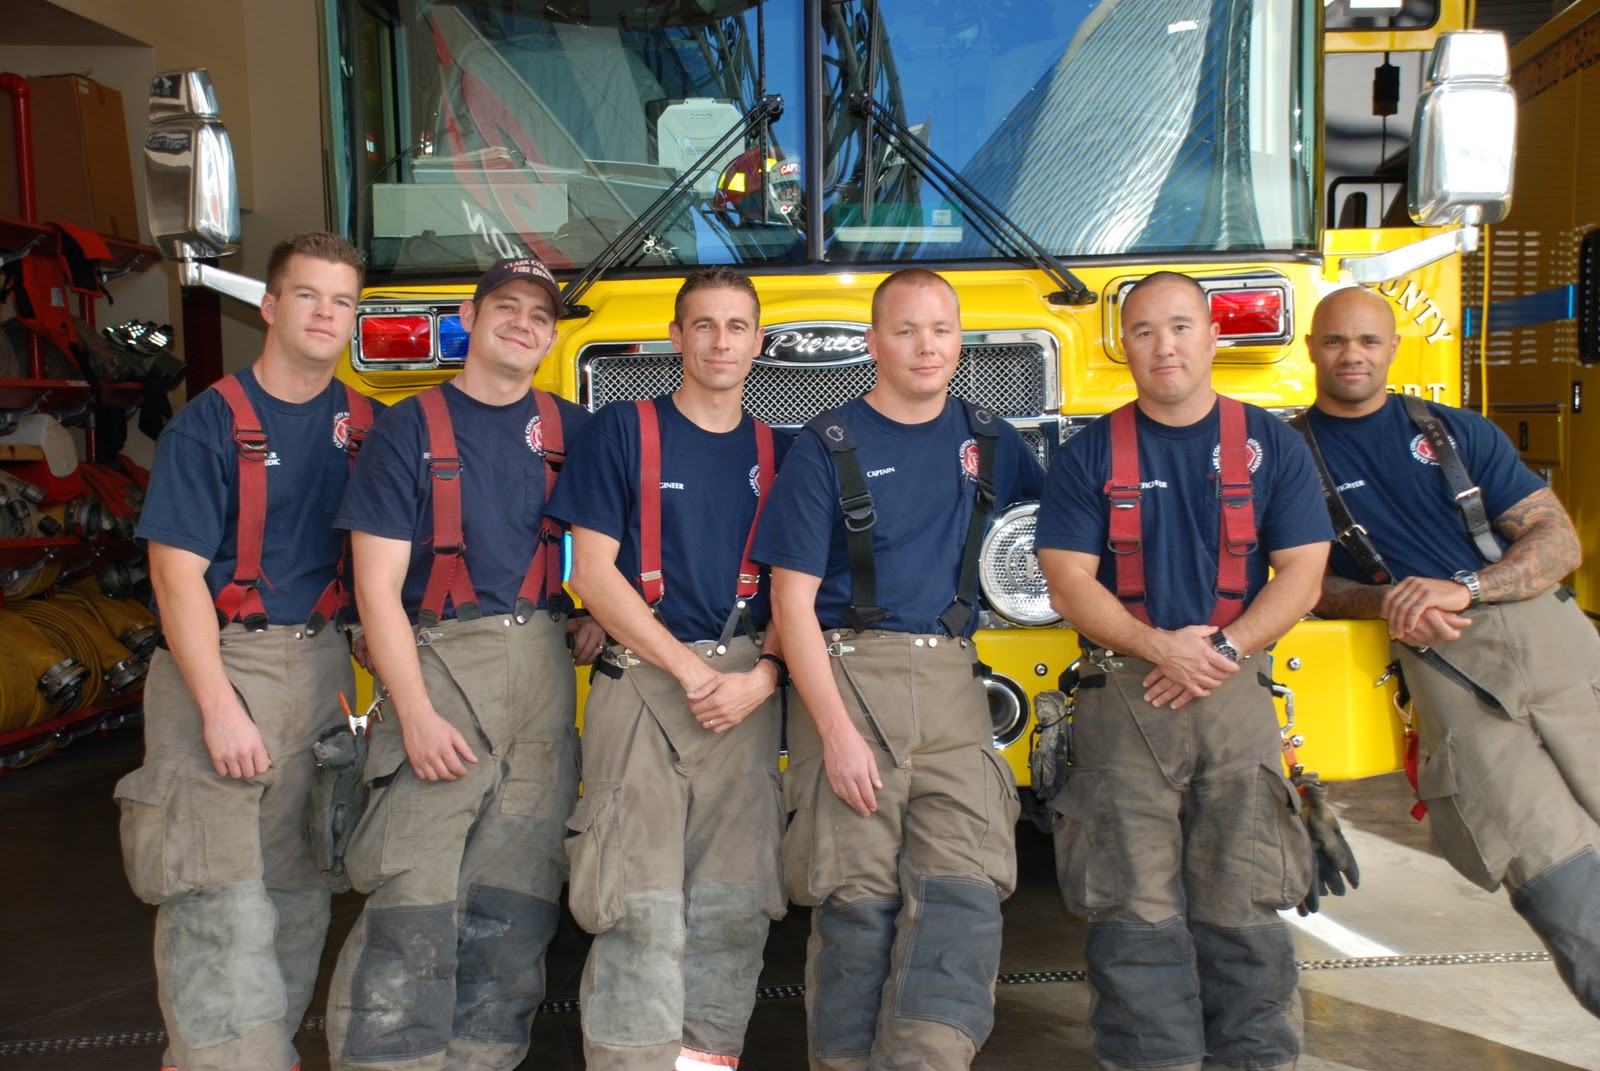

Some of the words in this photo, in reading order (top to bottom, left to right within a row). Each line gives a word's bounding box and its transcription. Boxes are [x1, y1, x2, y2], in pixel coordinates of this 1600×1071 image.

[504, 260, 530, 269] CLARK
[513, 266, 531, 274] FIRE
[765, 331, 867, 357] Pierce
[525, 434, 537, 453] CLARK
[866, 466, 896, 478] CAPTAIN
[659, 481, 685, 490] GINEER
